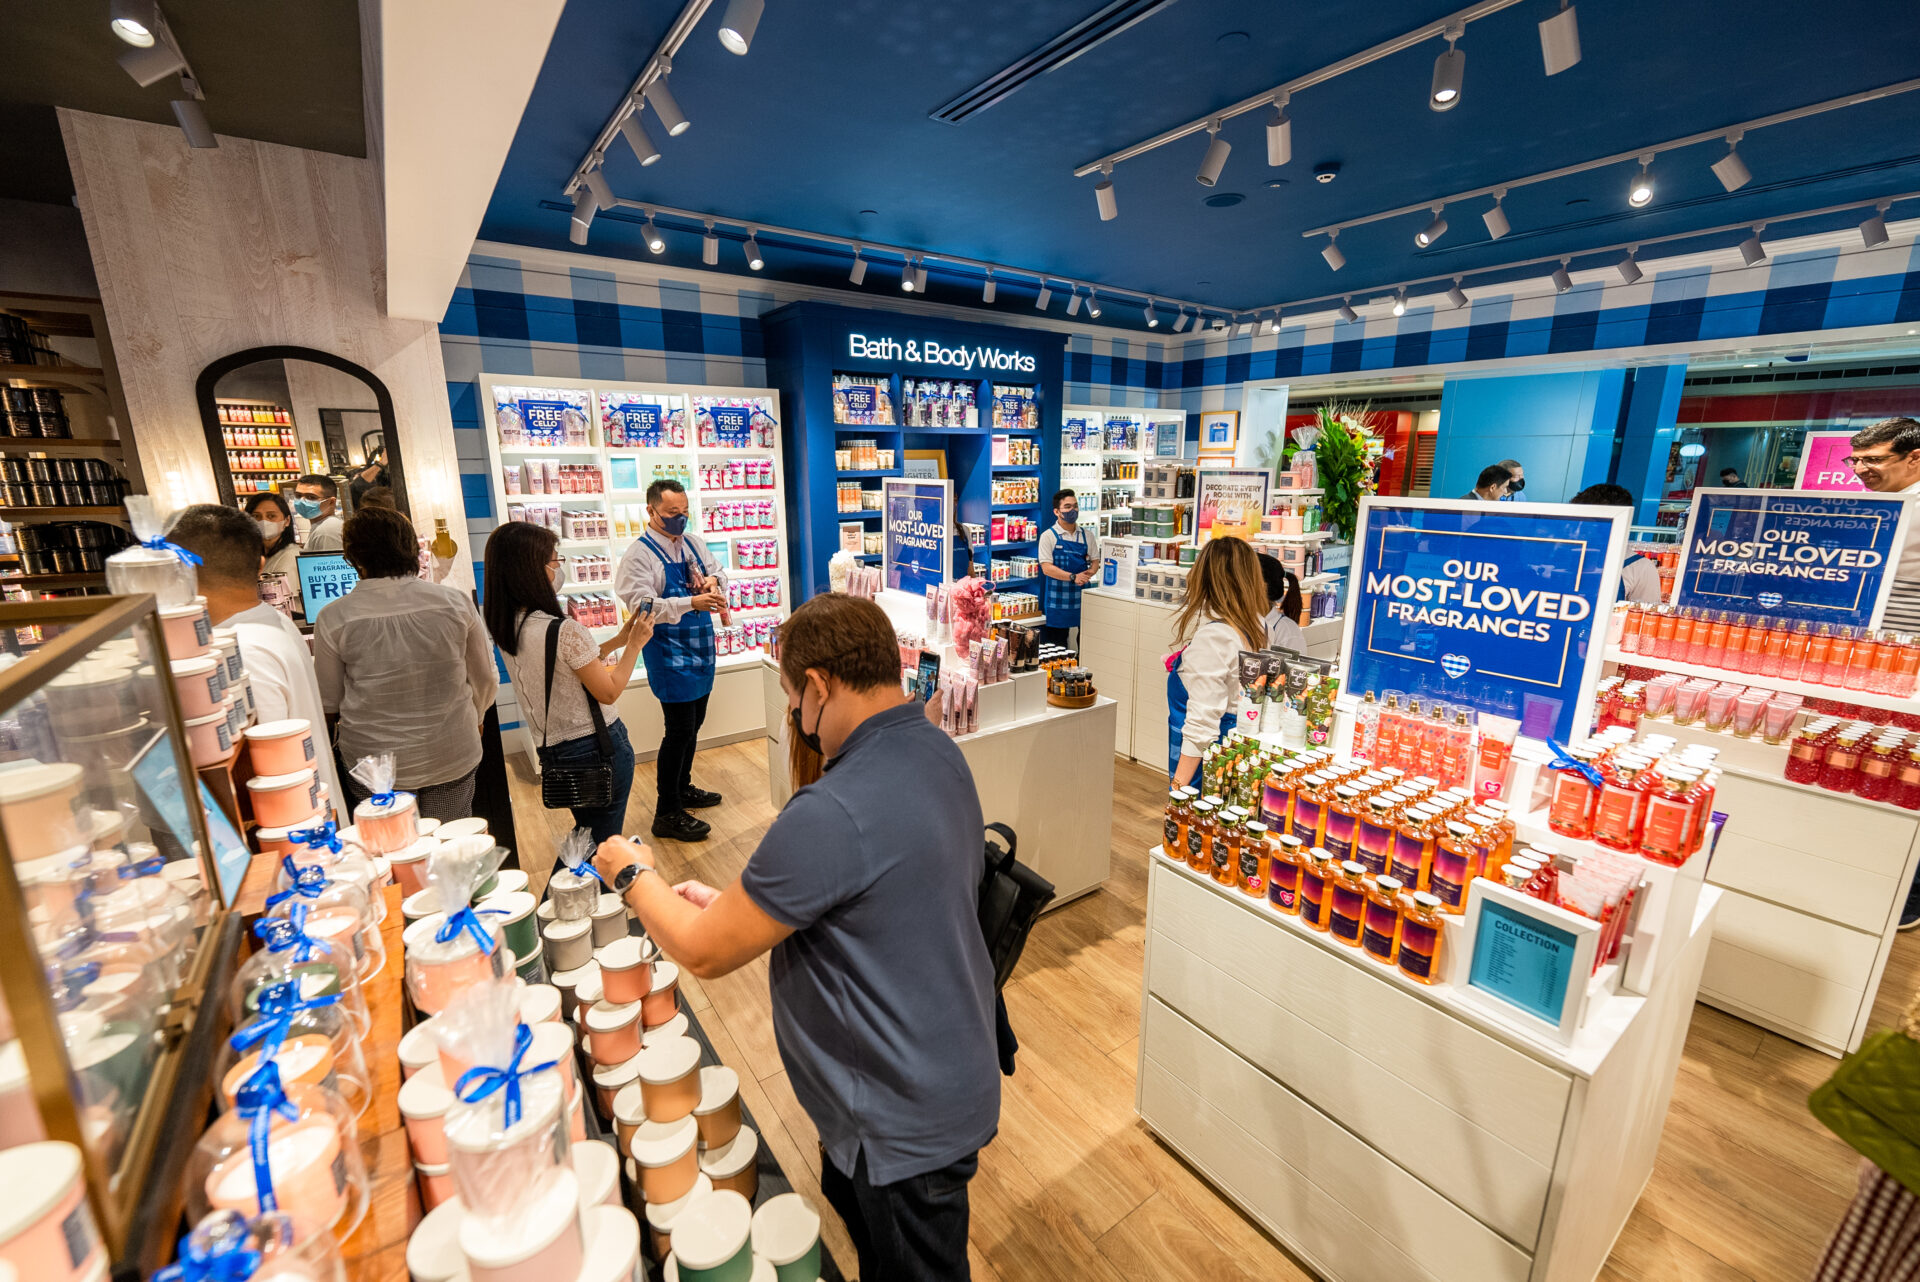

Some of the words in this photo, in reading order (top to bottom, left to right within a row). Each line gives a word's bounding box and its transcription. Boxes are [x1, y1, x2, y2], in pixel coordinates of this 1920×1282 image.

[849, 333, 902, 361] Bath
[904, 340, 922, 363] &
[924, 341, 976, 371] Body
[976, 346, 1036, 372] Works
[849, 393, 871, 403] FREE
[528, 409, 562, 421] FREE
[626, 413, 656, 423] FREE
[717, 415, 744, 426] FREE
[629, 422, 652, 430] CELLO
[1205, 484, 1239, 492] DECORATE
[908, 510, 923, 521] OUR
[888, 519, 944, 539] MOST-LOVED
[1763, 529, 1810, 544] OUR
[895, 534, 937, 550] FRAGRANCES
[1694, 538, 1882, 569] MOST-LOVED
[308, 575, 327, 583] BUY
[330, 574, 337, 582] 3
[341, 572, 358, 581] GET
[1442, 559, 1499, 582] OUR
[1712, 558, 1849, 583] FRAGRANCES
[310, 581, 352, 599] FRE
[1365, 571, 1591, 622] MOST-LOVED
[1387, 601, 1551, 643] FRAGRANCES
[1494, 920, 1561, 953] COLLECTION
